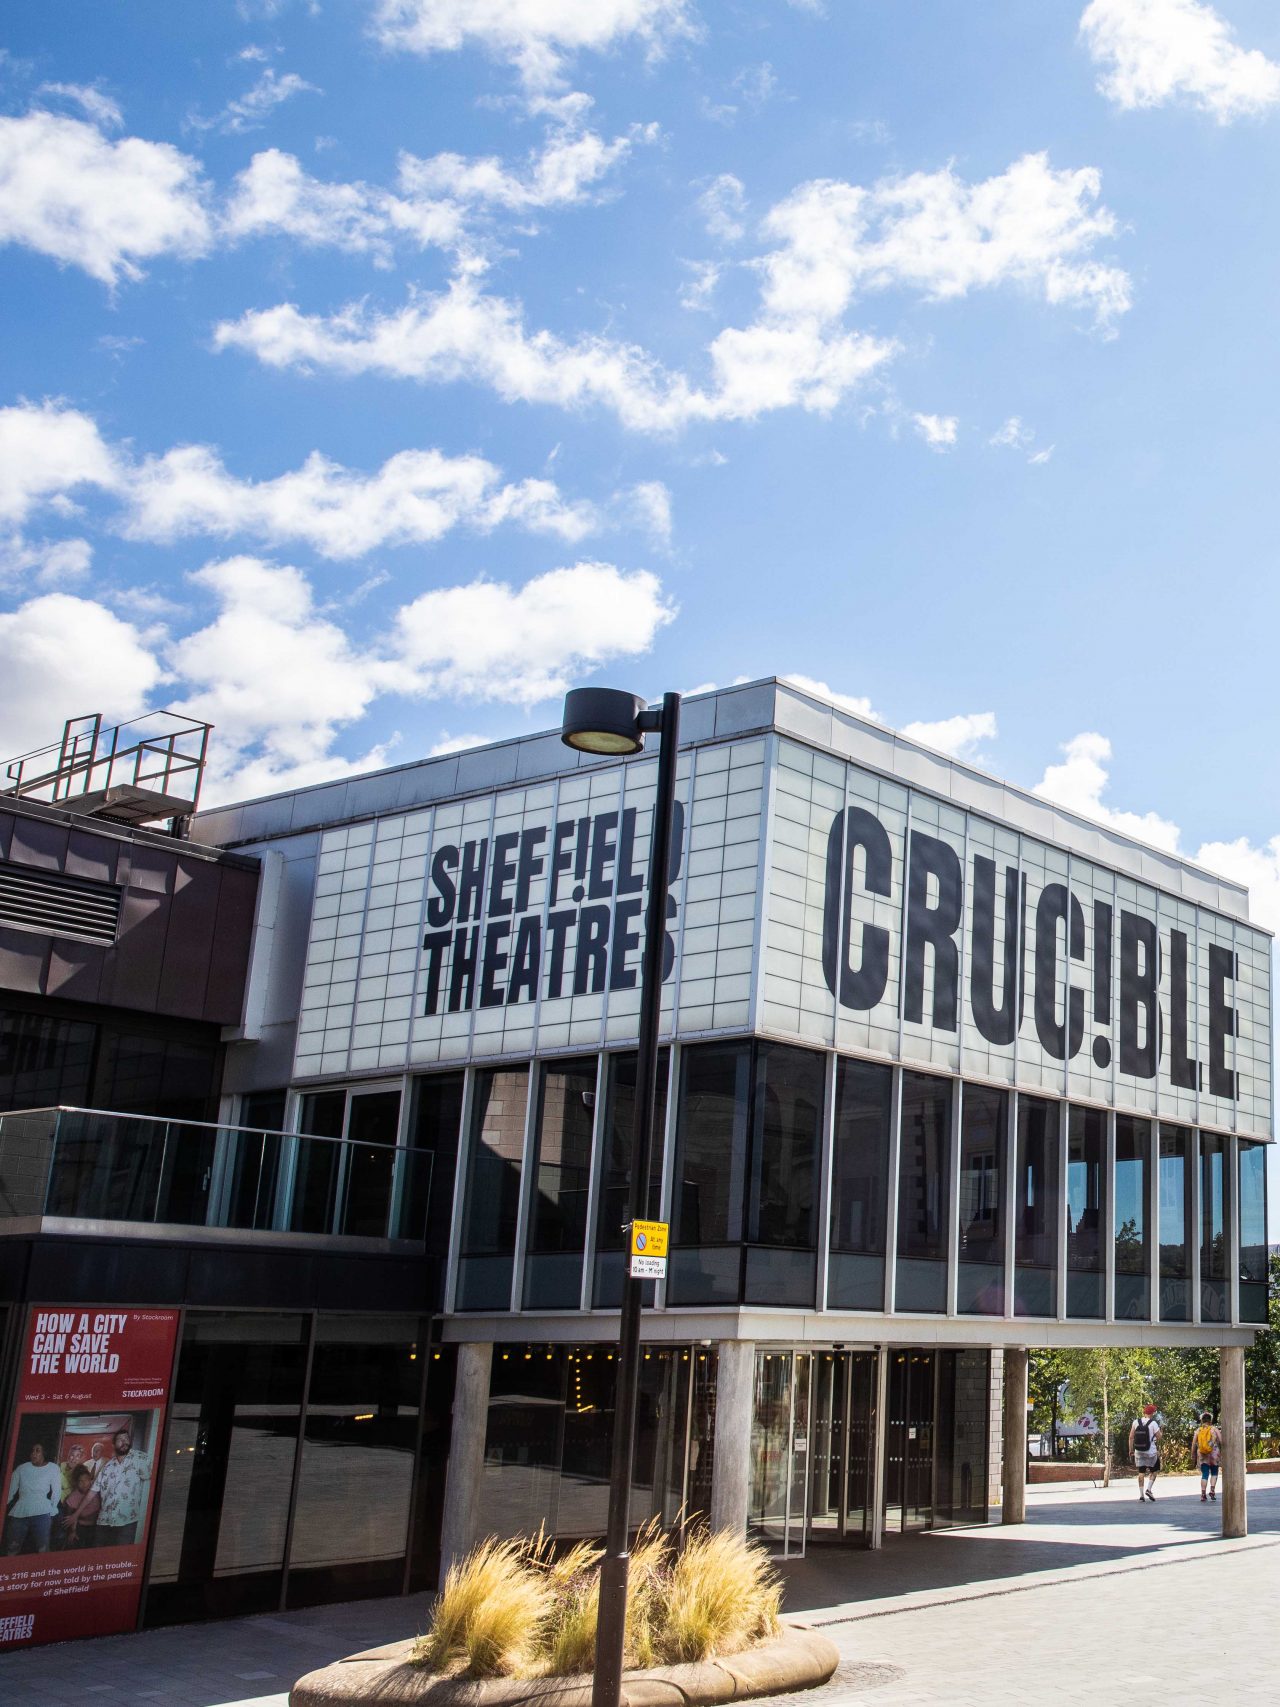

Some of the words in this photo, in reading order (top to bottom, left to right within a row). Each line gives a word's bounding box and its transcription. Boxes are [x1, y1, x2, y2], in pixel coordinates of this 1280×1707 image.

[635, 1223, 656, 1231] Pedestrian
[36, 1313, 75, 1334] HOW
[78, 1314, 89, 1334] A
[94, 1314, 127, 1334] CITY
[33, 1334, 66, 1354] CAN
[70, 1334, 111, 1353] SAVE
[31, 1354, 59, 1374] THE
[65, 1354, 119, 1373] WORLD
[122, 1388, 163, 1397] STOCKROOM
[12, 1572, 28, 1580] 2116
[106, 1561, 138, 1569] trouble...
[107, 1571, 132, 1580] people
[54, 1585, 89, 1595] Sheffield
